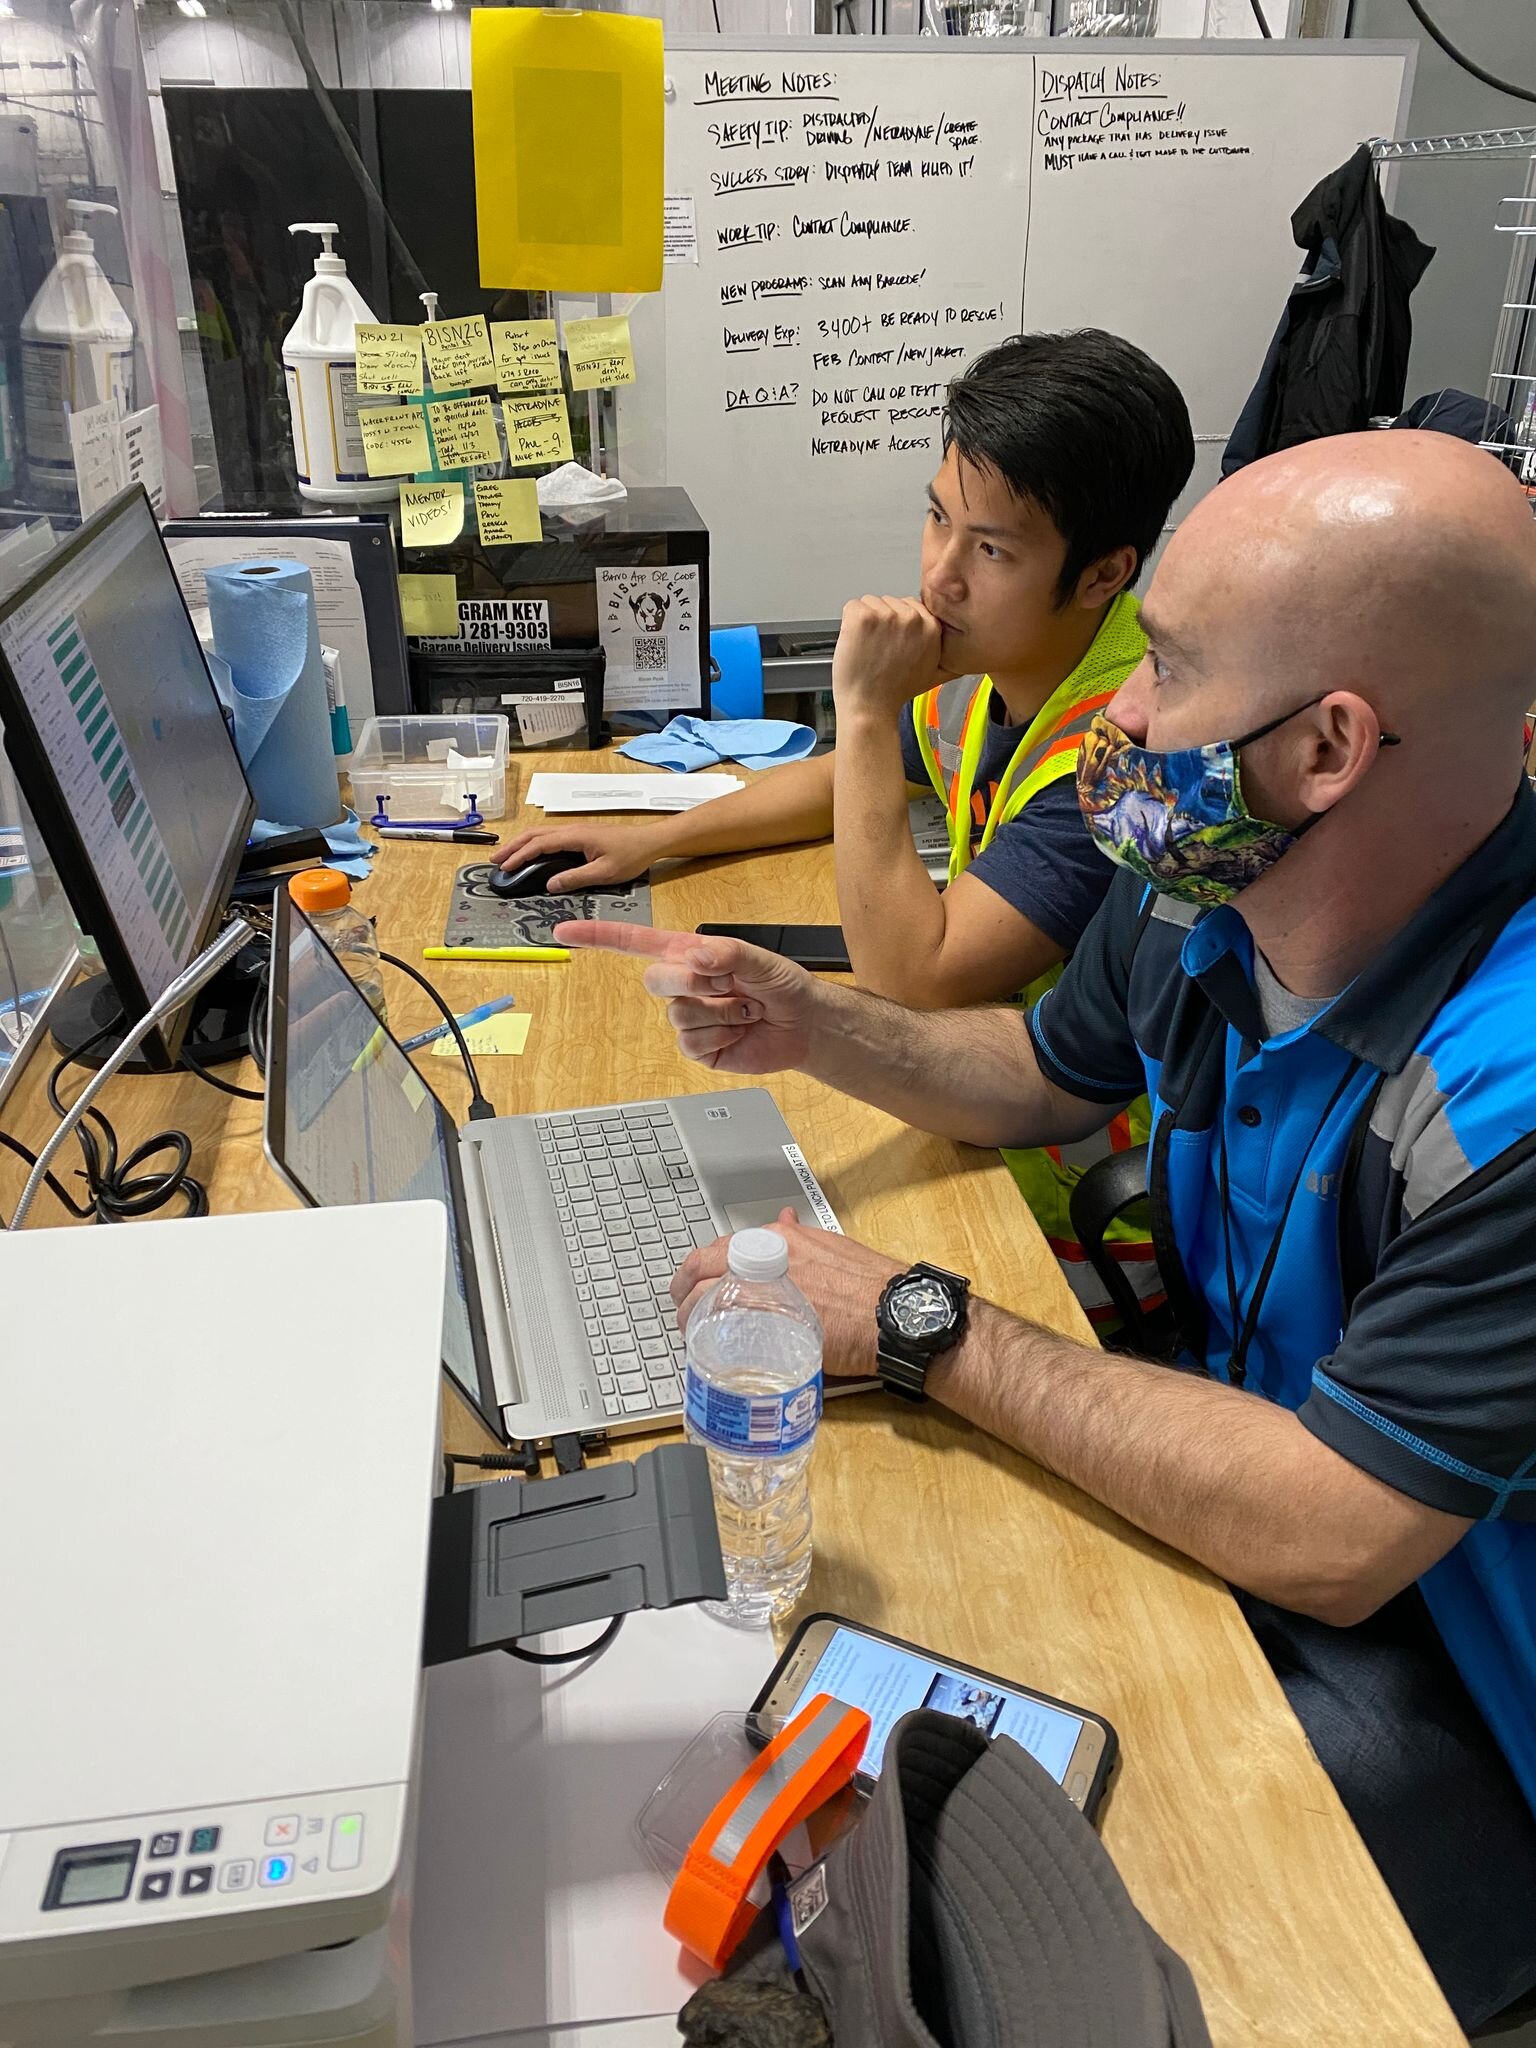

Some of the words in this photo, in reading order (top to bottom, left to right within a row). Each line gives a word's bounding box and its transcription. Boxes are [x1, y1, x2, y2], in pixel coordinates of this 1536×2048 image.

[704, 71, 772, 97] MEETING
[782, 71, 838, 93] NOTES:
[1041, 66, 1106, 101] DISPATCH
[1115, 63, 1162, 92] NOTES:
[1037, 108, 1099, 136] CONTACT
[707, 120, 761, 149] SAFETY
[1044, 136, 1064, 151] ANY
[1067, 133, 1106, 149] PACKAGE
[1135, 131, 1153, 141] HAS
[1158, 130, 1200, 145] DELIVERY
[1203, 128, 1228, 138] ISSUE
[886, 159, 914, 178] TEAM
[1044, 153, 1076, 171] MUST
[1108, 151, 1127, 159] CALL
[710, 167, 768, 191] SUCCESS
[717, 224, 756, 245] WORK
[792, 214, 838, 238] CONTACT
[720, 283, 747, 301] NEW
[818, 276, 846, 290] SCAN
[851, 274, 872, 291] ANY
[424, 321, 484, 346] BISN26
[817, 315, 873, 339] 3400+
[881, 312, 896, 327] BE
[899, 309, 940, 327] READY
[945, 307, 958, 323] TO
[390, 332, 403, 342] 21
[723, 326, 769, 348] DELIVERY
[812, 352, 842, 371] FEB
[726, 389, 750, 408] DA
[812, 388, 829, 407] DO
[834, 389, 859, 404] NOT
[863, 386, 886, 403] CALL
[889, 385, 906, 400] OR
[910, 383, 942, 398] TEXT
[821, 408, 881, 427] REQUEST
[811, 437, 881, 457] NETRADYNE
[887, 435, 931, 452] ACCESS
[405, 488, 453, 507] MENTOR
[512, 602, 543, 621] KEY
[470, 622, 549, 640] 281-9303
[420, 641, 462, 653] Garage
[464, 641, 511, 653] Delivery
[512, 641, 550, 653] Issues
[797, 1167, 817, 1191] PUNCH
[809, 1190, 829, 1214] LUNCH
